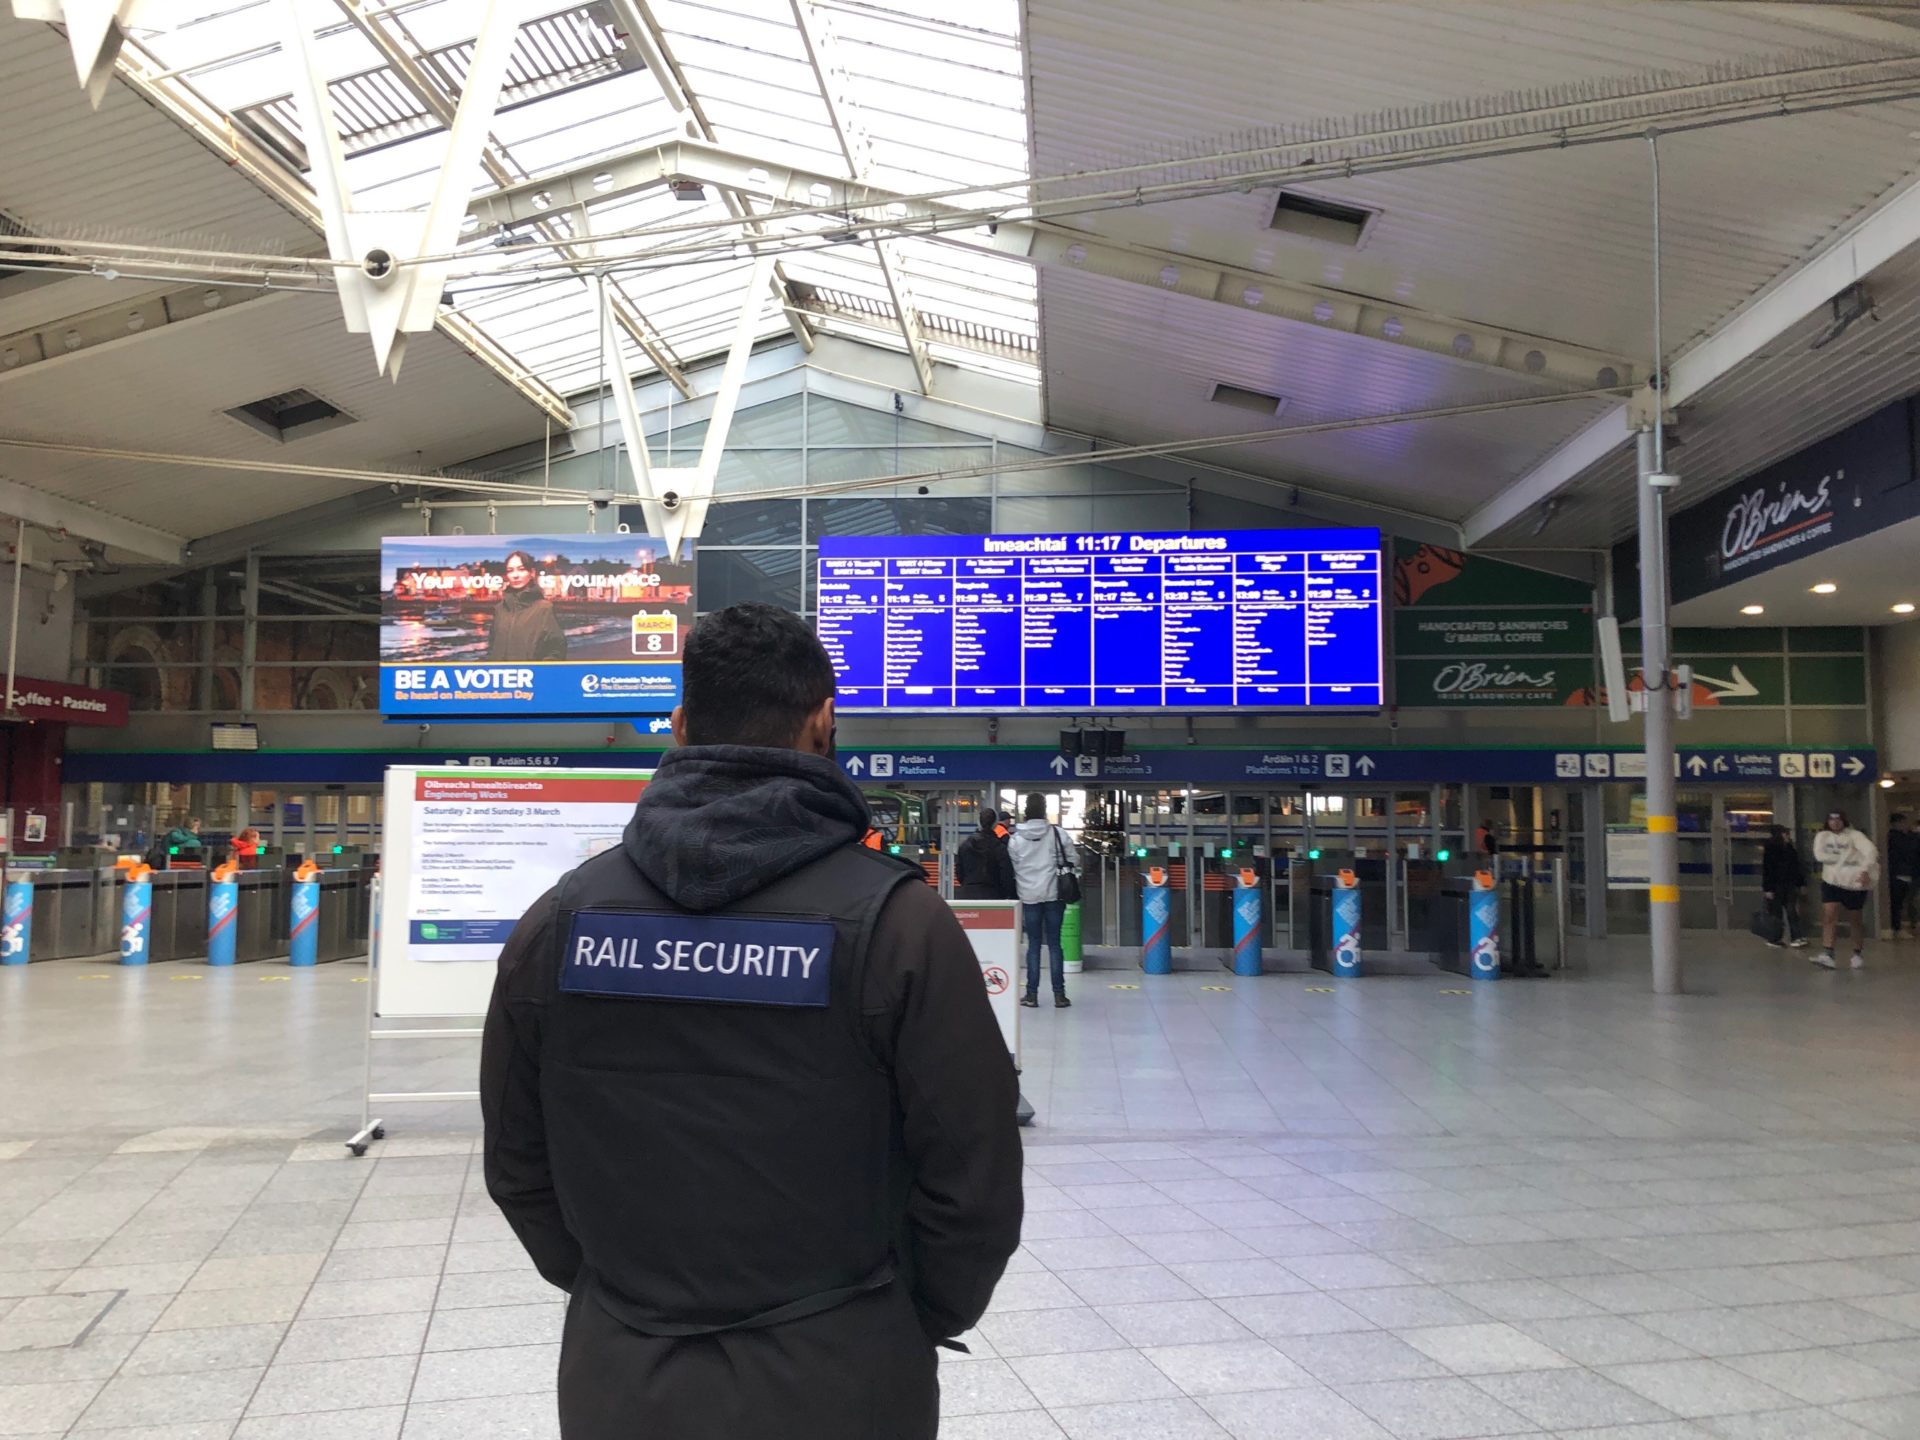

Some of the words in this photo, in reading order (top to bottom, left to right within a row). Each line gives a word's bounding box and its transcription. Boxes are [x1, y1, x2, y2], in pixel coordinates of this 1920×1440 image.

[1721, 476, 1830, 557] O'Briens
[1076, 536, 1121, 551] 11:17
[1130, 536, 1227, 553] Departures
[411, 572, 456, 589] Your
[460, 573, 503, 588] vote
[538, 571, 557, 588] is
[560, 574, 606, 597] your
[607, 570, 661, 587] voice
[1419, 622, 1496, 631] HANDCRAFTED
[1498, 621, 1569, 630] SANDWICHES
[647, 634, 662, 651] 8
[1457, 634, 1502, 642] BARISTA
[1504, 633, 1544, 642] COFFEE
[395, 670, 426, 689] BE
[431, 669, 450, 689] A
[454, 669, 534, 689] VOTER
[1433, 662, 1556, 692] O'Briens
[63, 696, 107, 712] Pastries
[649, 718, 672, 733] glob
[543, 756, 551, 765] &
[552, 756, 559, 765] 7
[899, 755, 925, 764] Ardán
[927, 755, 935, 764] 4
[1134, 755, 1140, 764] 3
[1301, 755, 1309, 764] &
[1311, 755, 1319, 763] 2
[899, 766, 937, 775] Platform
[938, 767, 946, 775] 4
[1104, 766, 1143, 774] Platform
[1145, 766, 1152, 774] 3
[1245, 765, 1291, 774] Platforms
[1299, 766, 1310, 774] to
[1311, 765, 1319, 774] 2
[1736, 766, 1773, 775] Toilets
[424, 790, 477, 800] Engineering
[479, 790, 508, 799] Works
[424, 807, 464, 816] Saturday
[466, 807, 472, 815] 2
[474, 807, 490, 815] and
[491, 807, 524, 816] Sunday
[574, 936, 644, 969] RAIL
[652, 940, 820, 979] SECURITY
